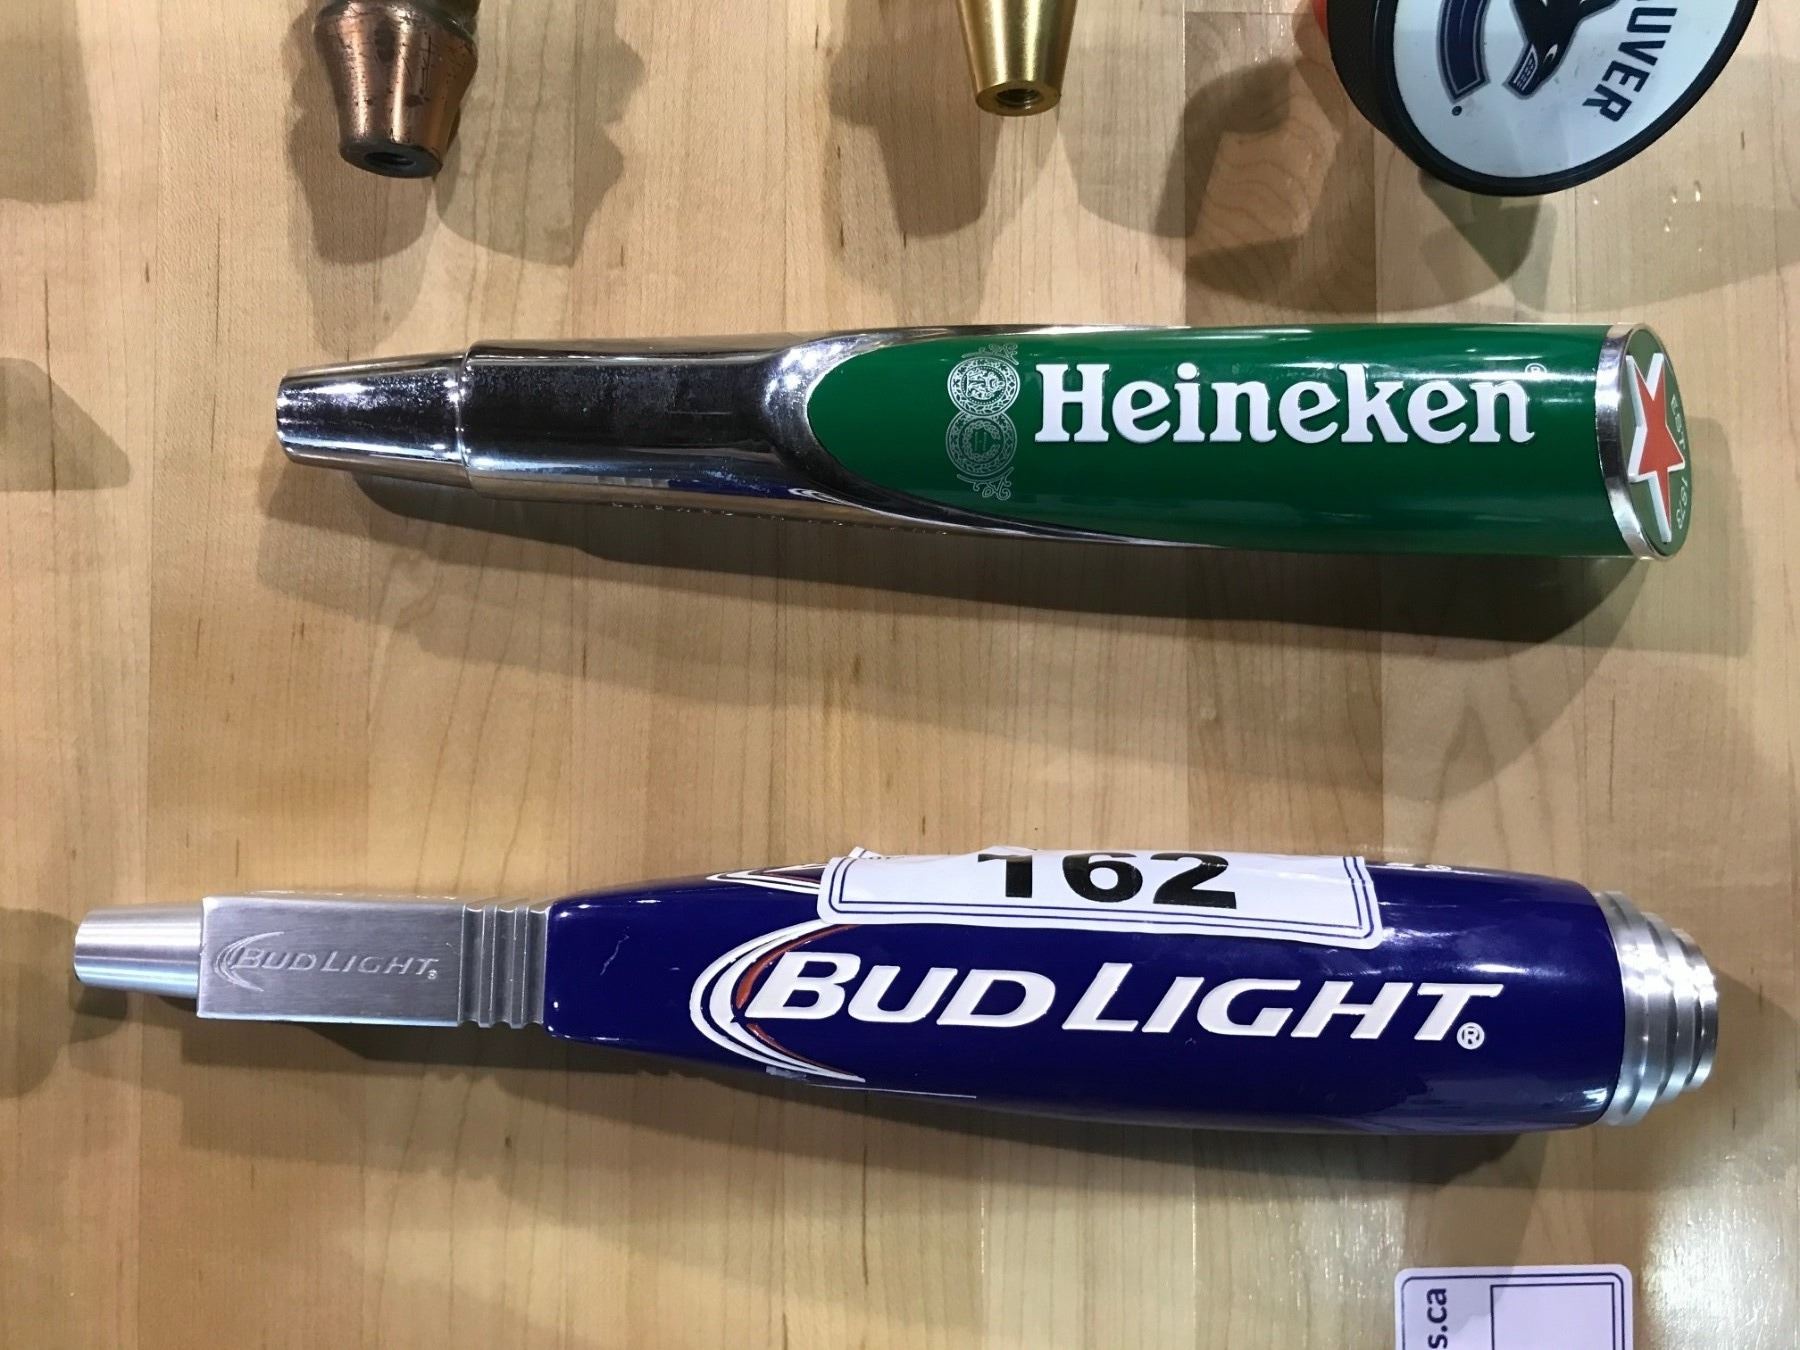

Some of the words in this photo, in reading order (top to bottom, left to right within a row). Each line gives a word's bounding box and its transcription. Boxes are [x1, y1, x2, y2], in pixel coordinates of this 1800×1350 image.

[977, 852, 1237, 909] 162
[229, 948, 317, 971] BUD
[744, 951, 1056, 1028] BUD
[1426, 1288, 1448, 1349] s.ca
